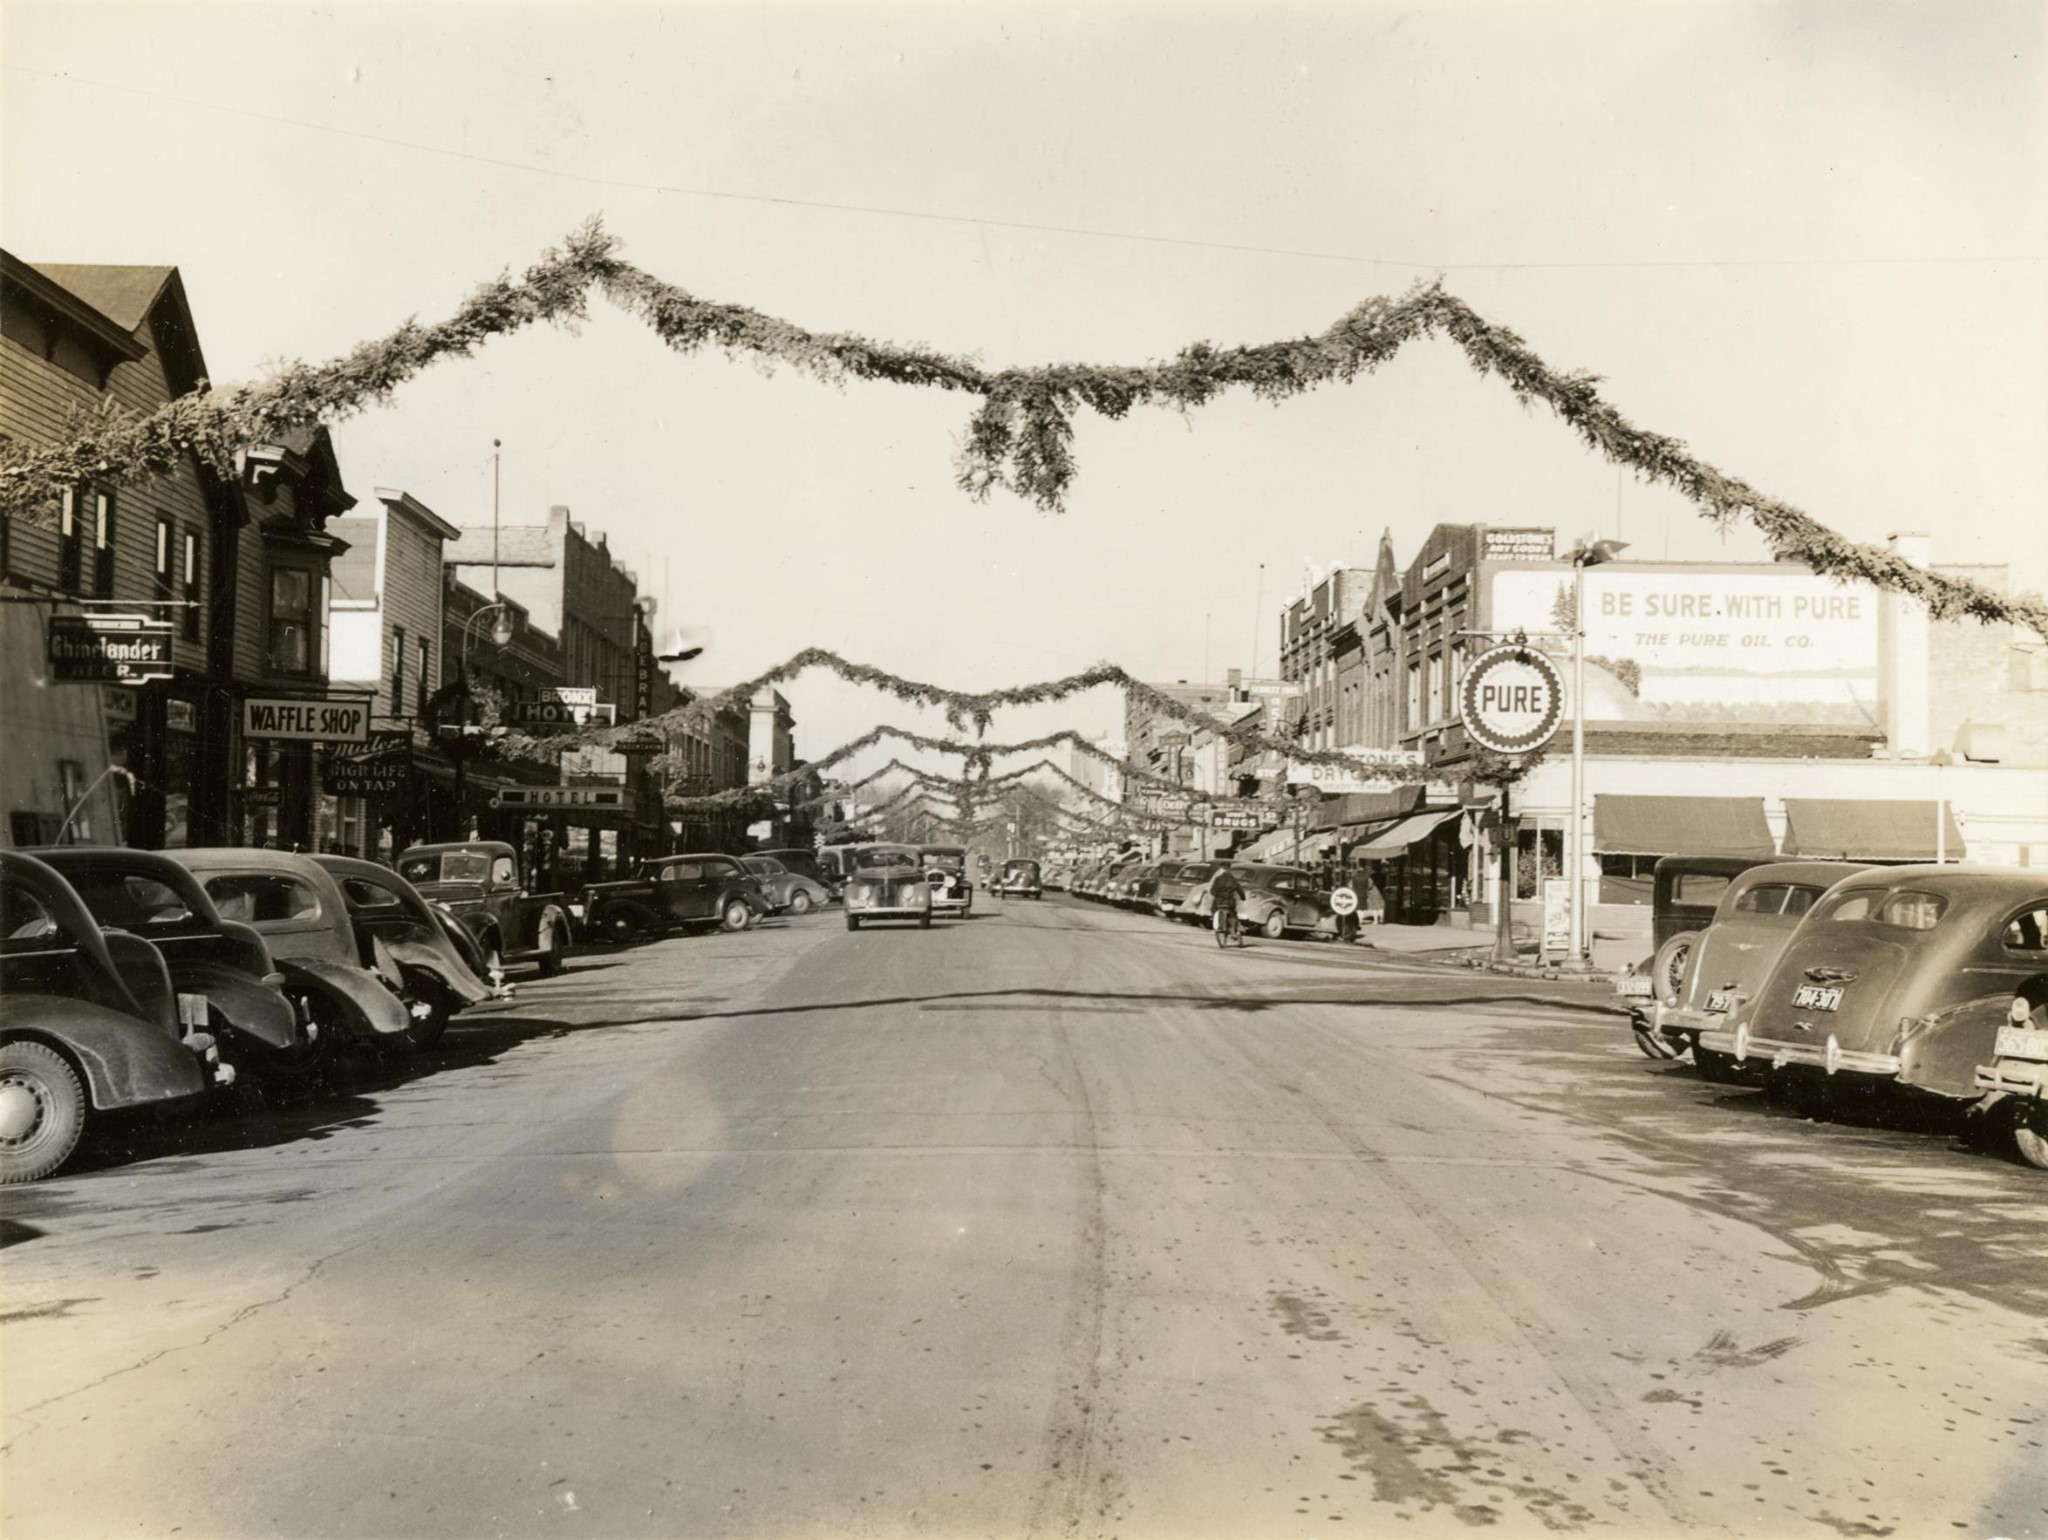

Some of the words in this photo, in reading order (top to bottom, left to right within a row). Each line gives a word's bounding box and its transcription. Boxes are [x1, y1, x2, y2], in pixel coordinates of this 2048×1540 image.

[1513, 545, 1549, 553] GOODS
[1601, 592, 1633, 616] BE
[1645, 593, 1711, 618] SURE
[1725, 594, 1782, 619] WITH
[1794, 596, 1861, 619] PURE
[1635, 633, 1669, 646] THE
[1679, 634, 1730, 647] PURE
[1741, 635, 1771, 648] OIL
[1785, 635, 1814, 648] CO.
[1482, 686, 1543, 713] PURE
[250, 705, 315, 732] WAFFLE
[320, 708, 361, 735] SHOP
[373, 764, 408, 778] LIFE
[1312, 767, 1346, 780] DRY
[337, 780, 360, 791] ON
[364, 780, 397, 791] TAP
[530, 791, 593, 804] HOTEL
[1214, 817, 1257, 827] DRUGS
